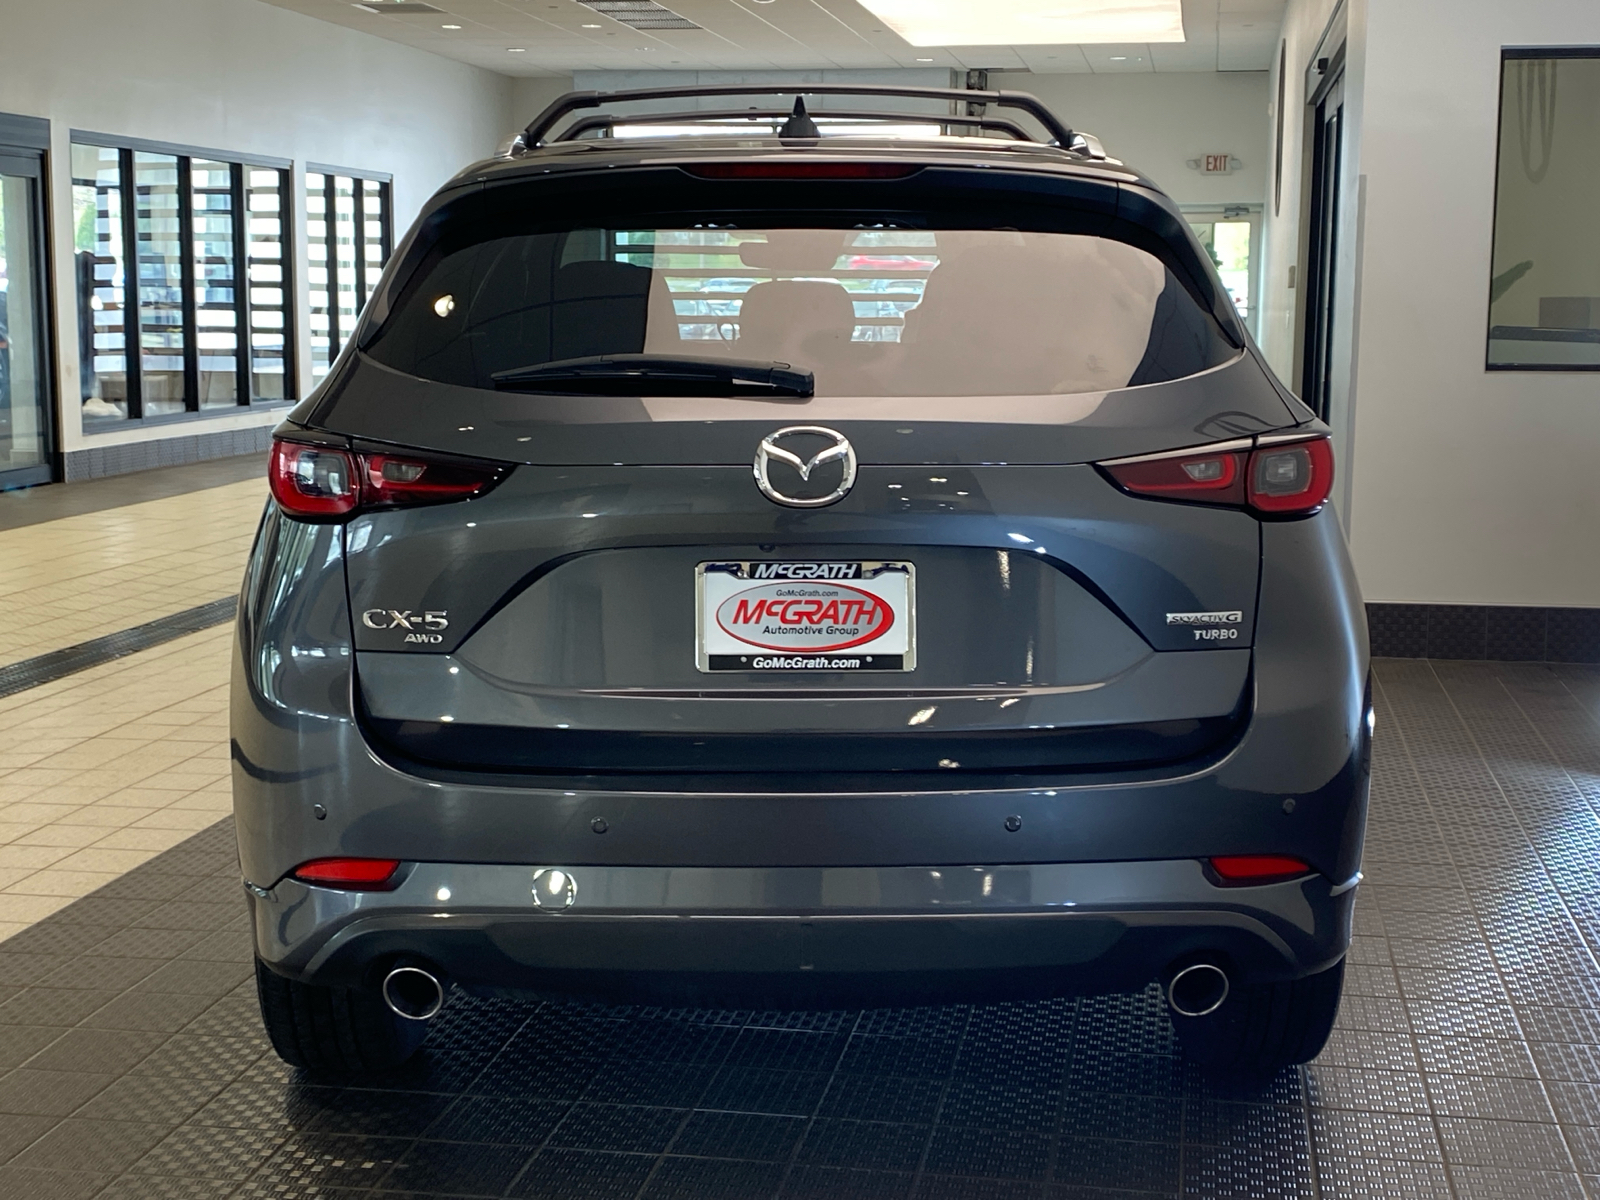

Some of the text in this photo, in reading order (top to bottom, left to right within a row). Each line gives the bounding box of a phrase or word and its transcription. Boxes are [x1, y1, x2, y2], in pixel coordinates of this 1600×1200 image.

[1206, 155, 1228, 171] EXIT
[776, 589, 838, 597] GoMcGrath.com
[362, 608, 449, 630] CX-5
[762, 625, 859, 637] Automotive Group
[1193, 628, 1238, 640] TURBO
[404, 633, 443, 644] AWD
[752, 656, 860, 668] GoMcGrath.com
